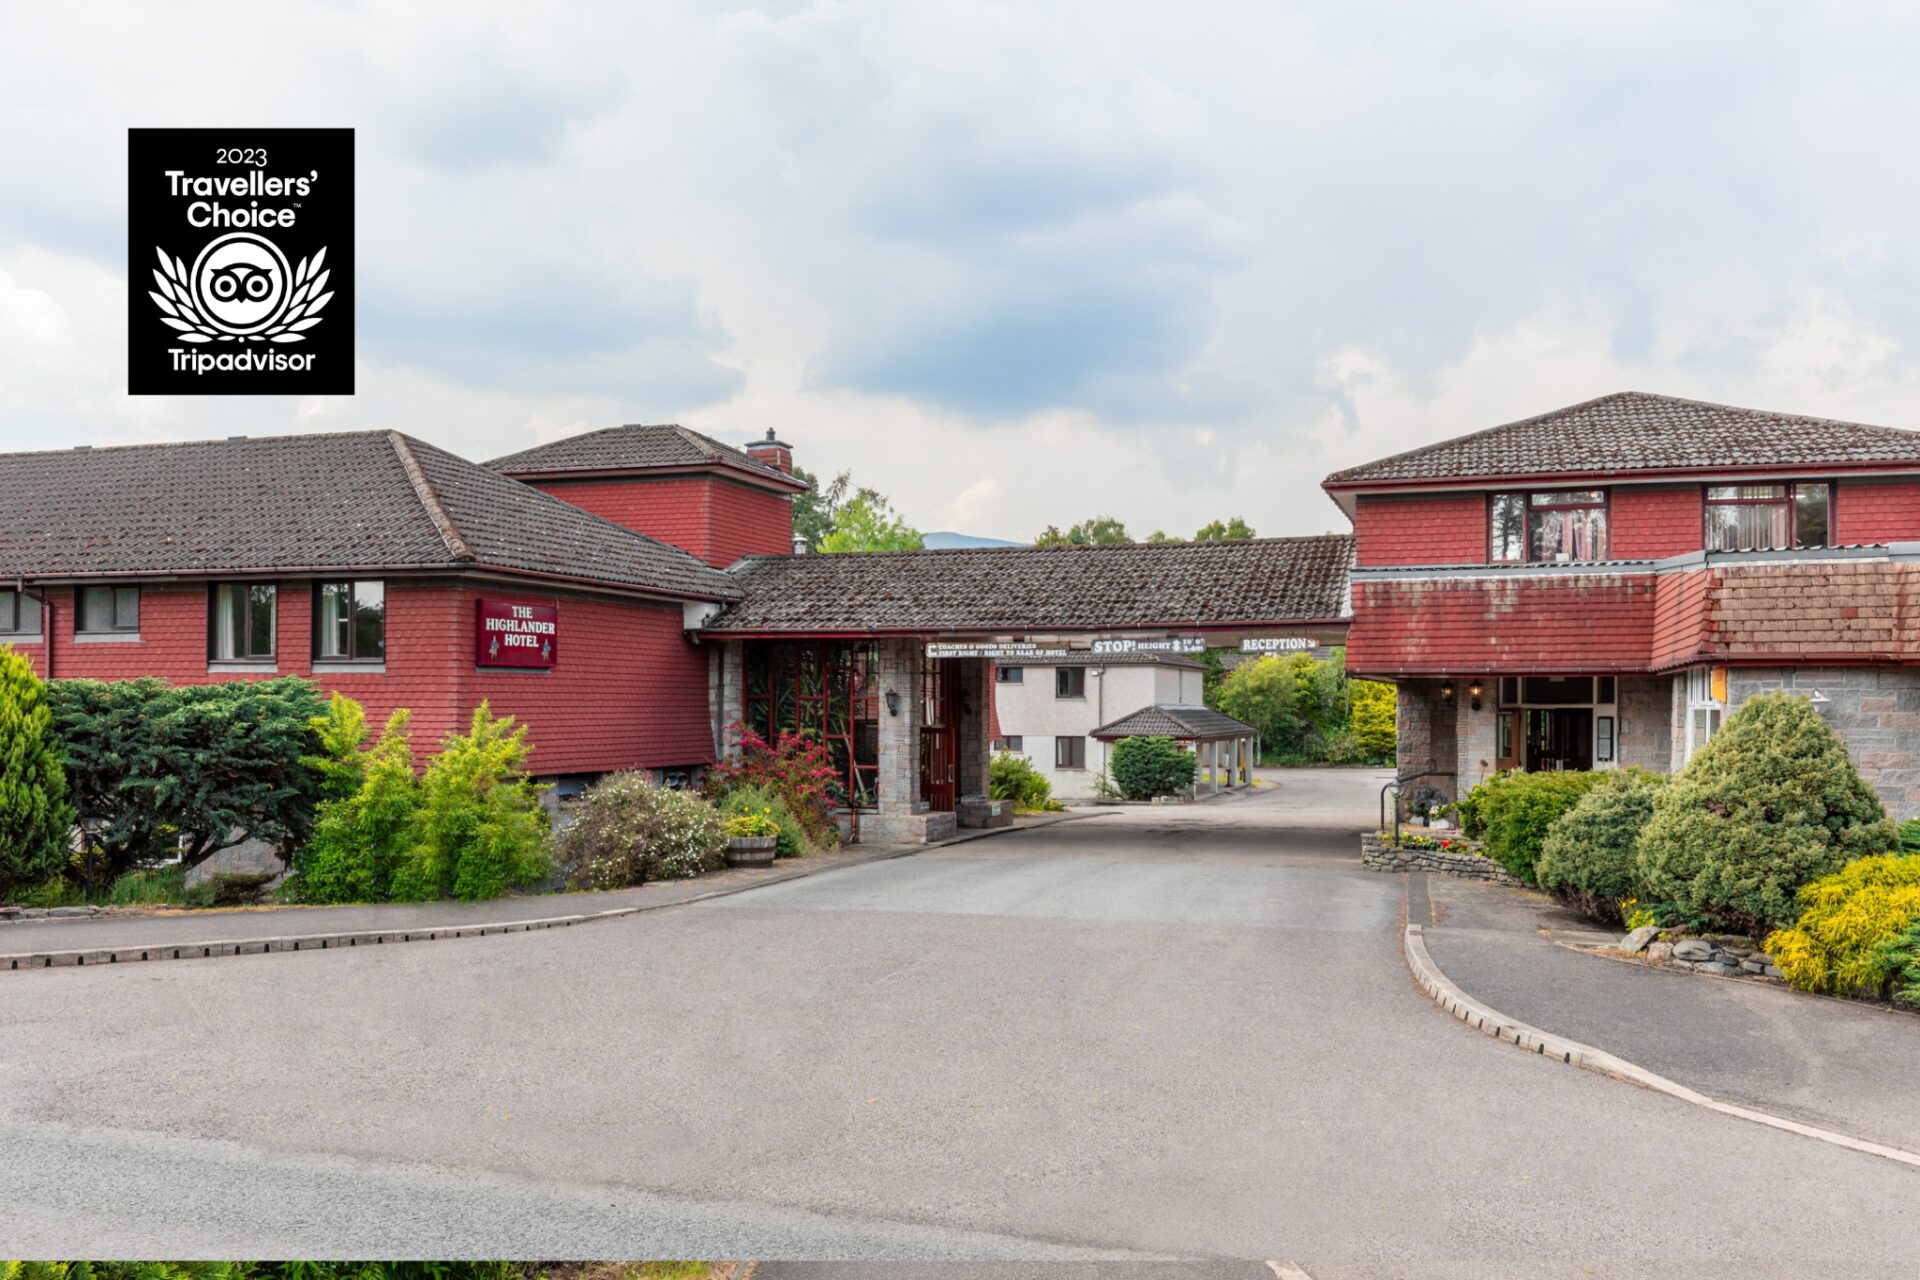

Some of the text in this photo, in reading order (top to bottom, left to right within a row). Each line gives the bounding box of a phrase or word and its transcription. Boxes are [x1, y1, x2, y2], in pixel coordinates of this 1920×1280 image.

[512, 605, 533, 619] THE
[486, 618, 555, 635] HIGHLANDER
[504, 633, 539, 648] HOTEL
[1094, 640, 1171, 653] STOP! HEIGHT
[1243, 638, 1306, 650] RECEPTION
